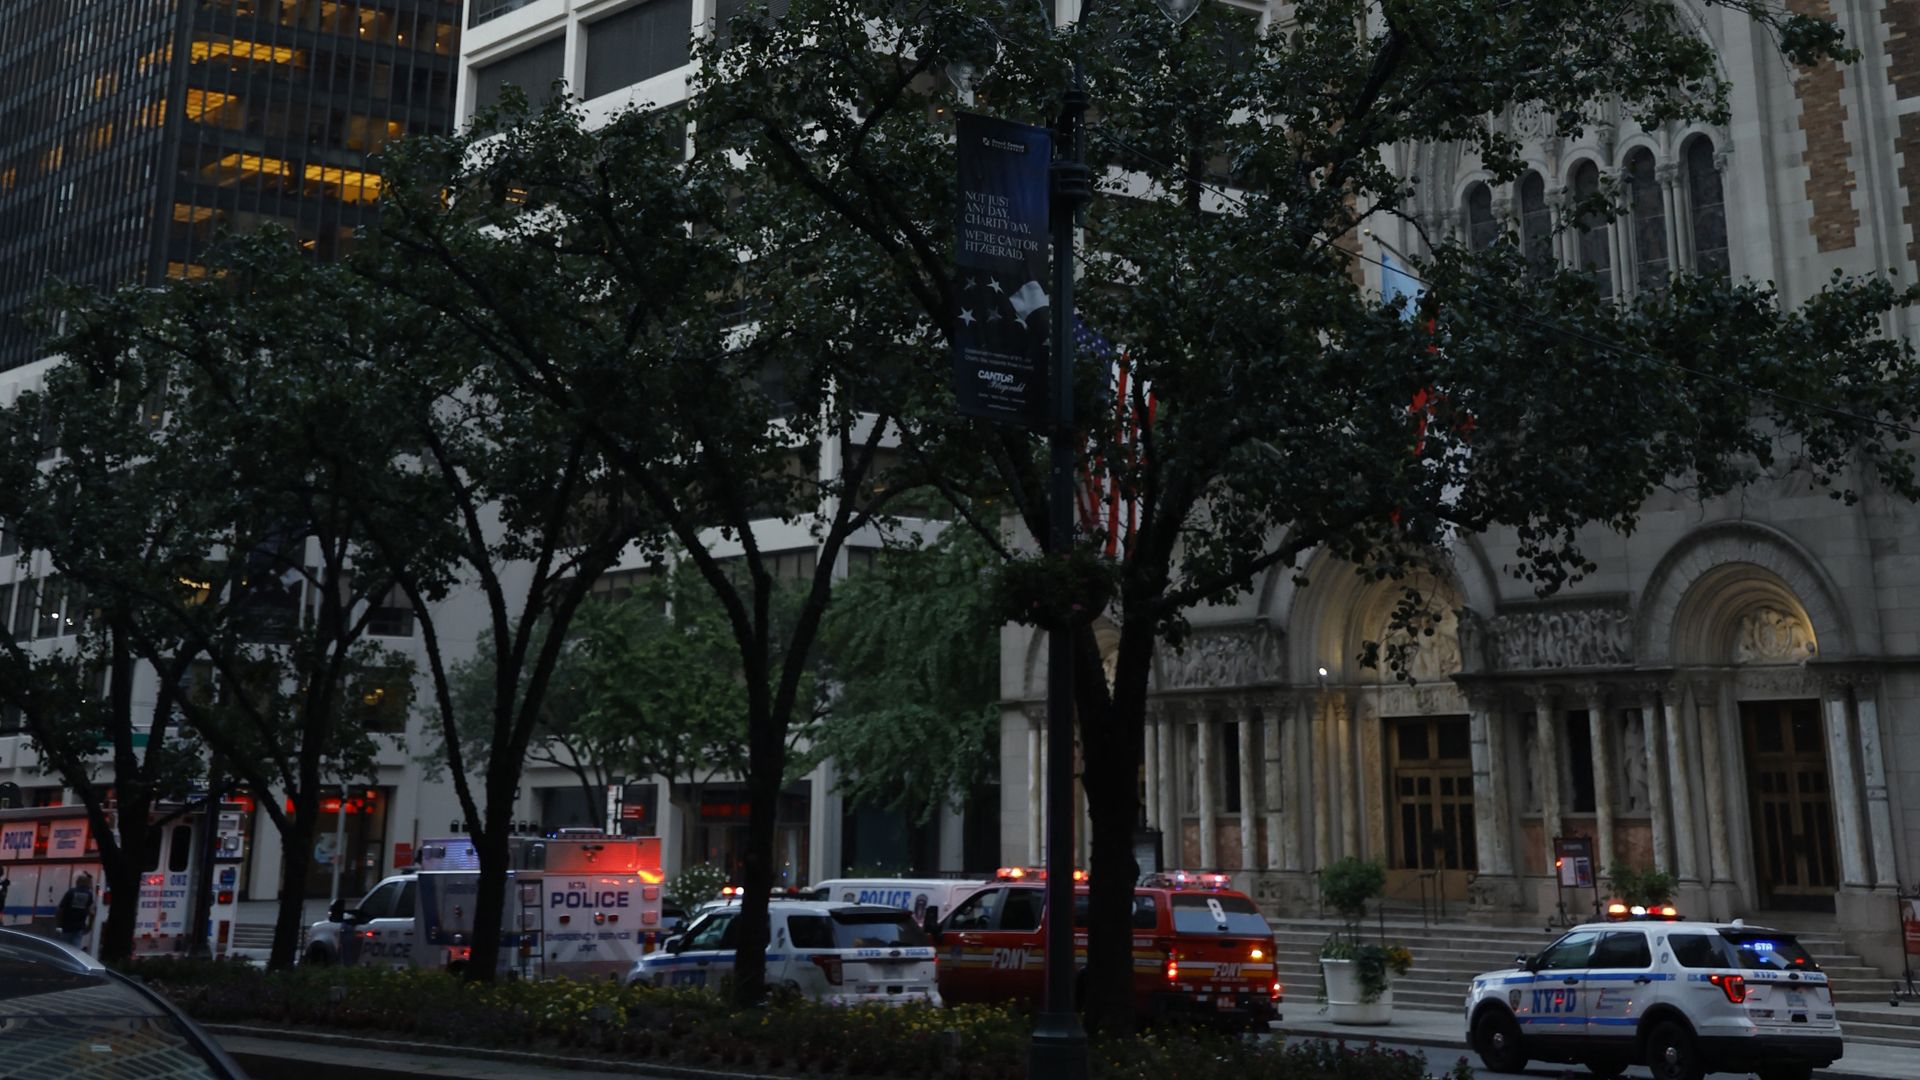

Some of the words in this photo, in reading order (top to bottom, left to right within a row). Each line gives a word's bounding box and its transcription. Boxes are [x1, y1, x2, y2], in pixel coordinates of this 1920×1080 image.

[965, 191, 986, 203] NOT
[988, 193, 1009, 207] JUST
[965, 202, 985, 215] ANY
[988, 205, 1010, 220] DAY,
[965, 213, 1010, 230] CHARITY
[1010, 221, 1031, 234] DAY.
[965, 241, 1025, 261] FITZGERALD.
[998, 234, 1039, 251] CANTOR
[978, 369, 1014, 383] CANTOR
[3, 831, 33, 850] POLICE
[551, 891, 629, 908] POLICE
[860, 890, 911, 911] POLICE
[1207, 898, 1226, 922] 8
[364, 942, 412, 957] POLICE
[992, 947, 1031, 970] FDNY
[1213, 962, 1242, 977] FDNY
[1532, 988, 1577, 1014] NYPD
